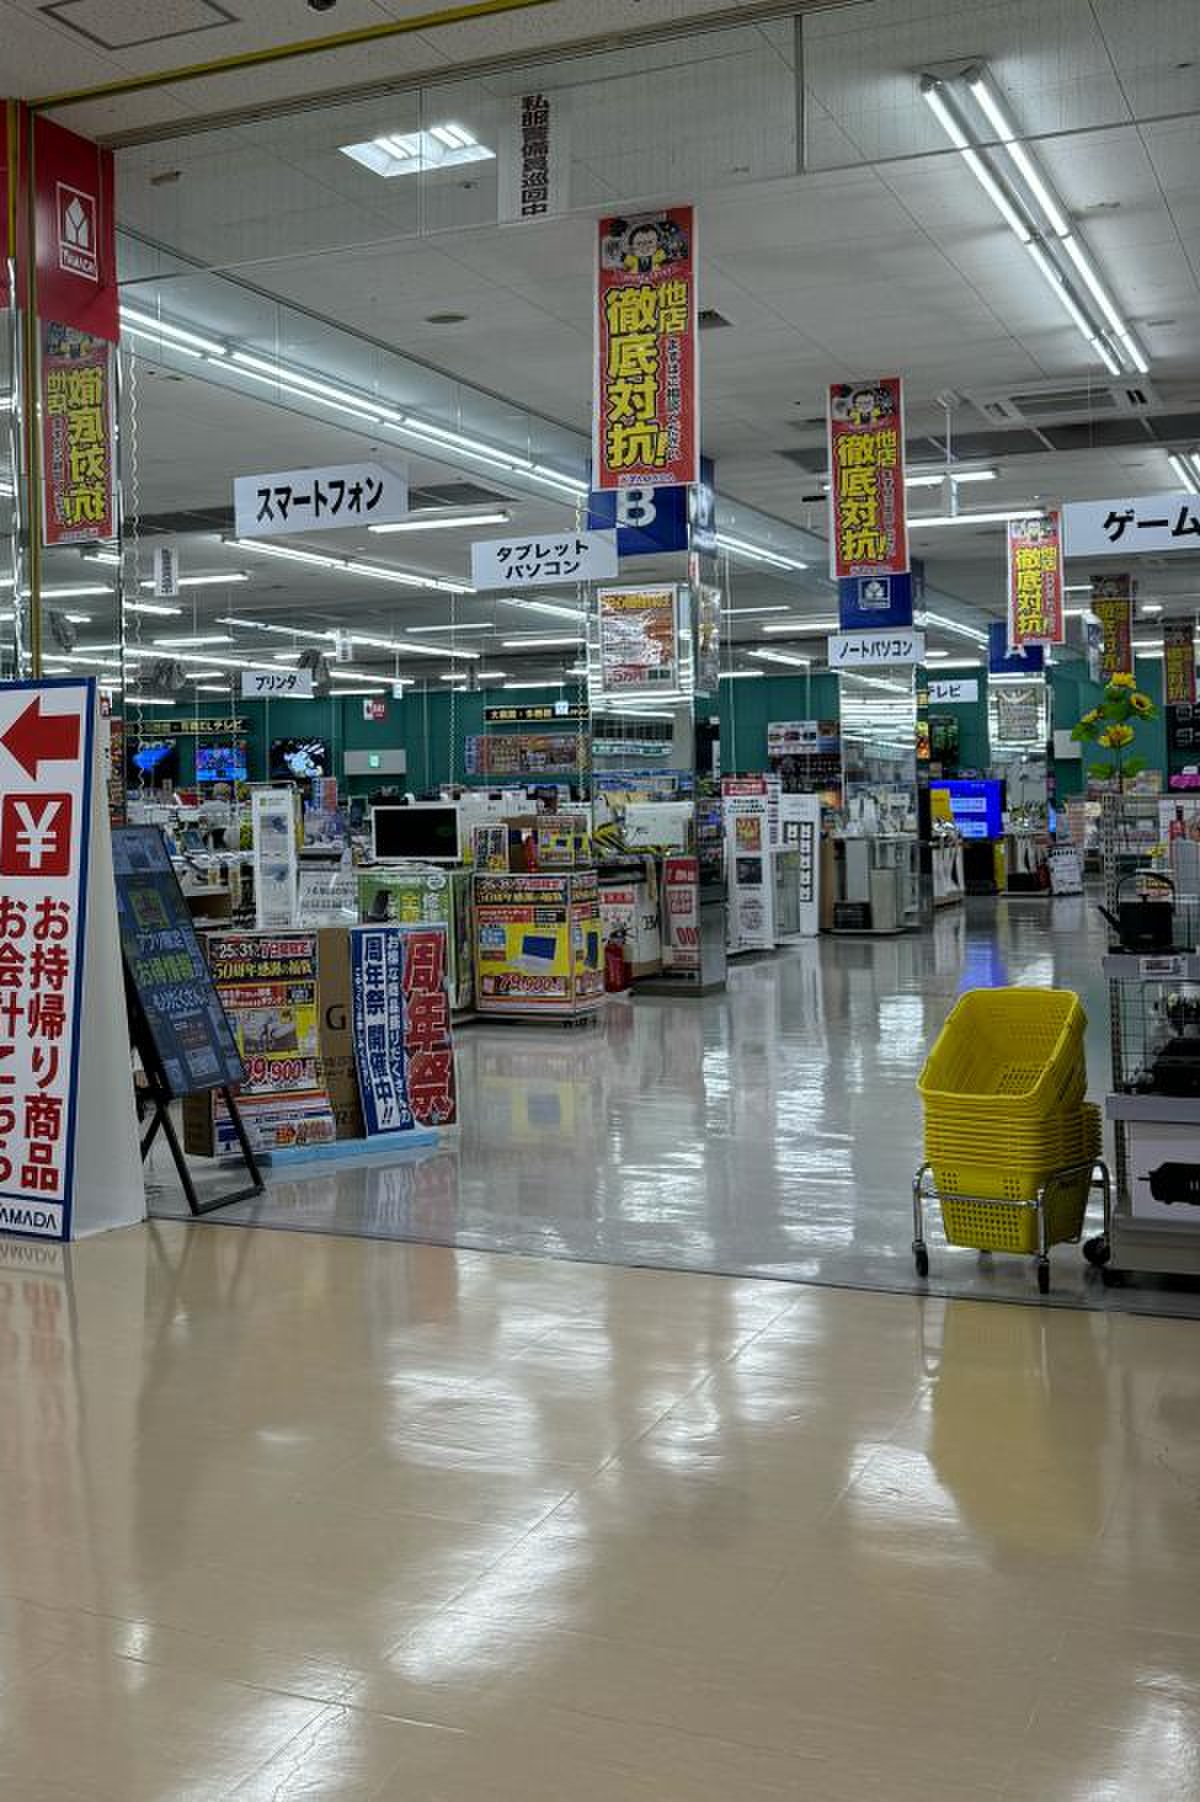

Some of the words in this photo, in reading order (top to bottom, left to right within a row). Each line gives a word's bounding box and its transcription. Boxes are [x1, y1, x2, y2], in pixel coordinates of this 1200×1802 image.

[62, 249, 97, 275] YAMADA
[256, 478, 384, 522] スマートフォン
[1103, 506, 1200, 541] ゲーム
[497, 540, 590, 562] タブレット
[504, 561, 580, 577] パソコン
[840, 640, 912, 659] ノートパソコン
[256, 674, 298, 690] プリンタ
[20, 896, 71, 1192] お持帰り商品
